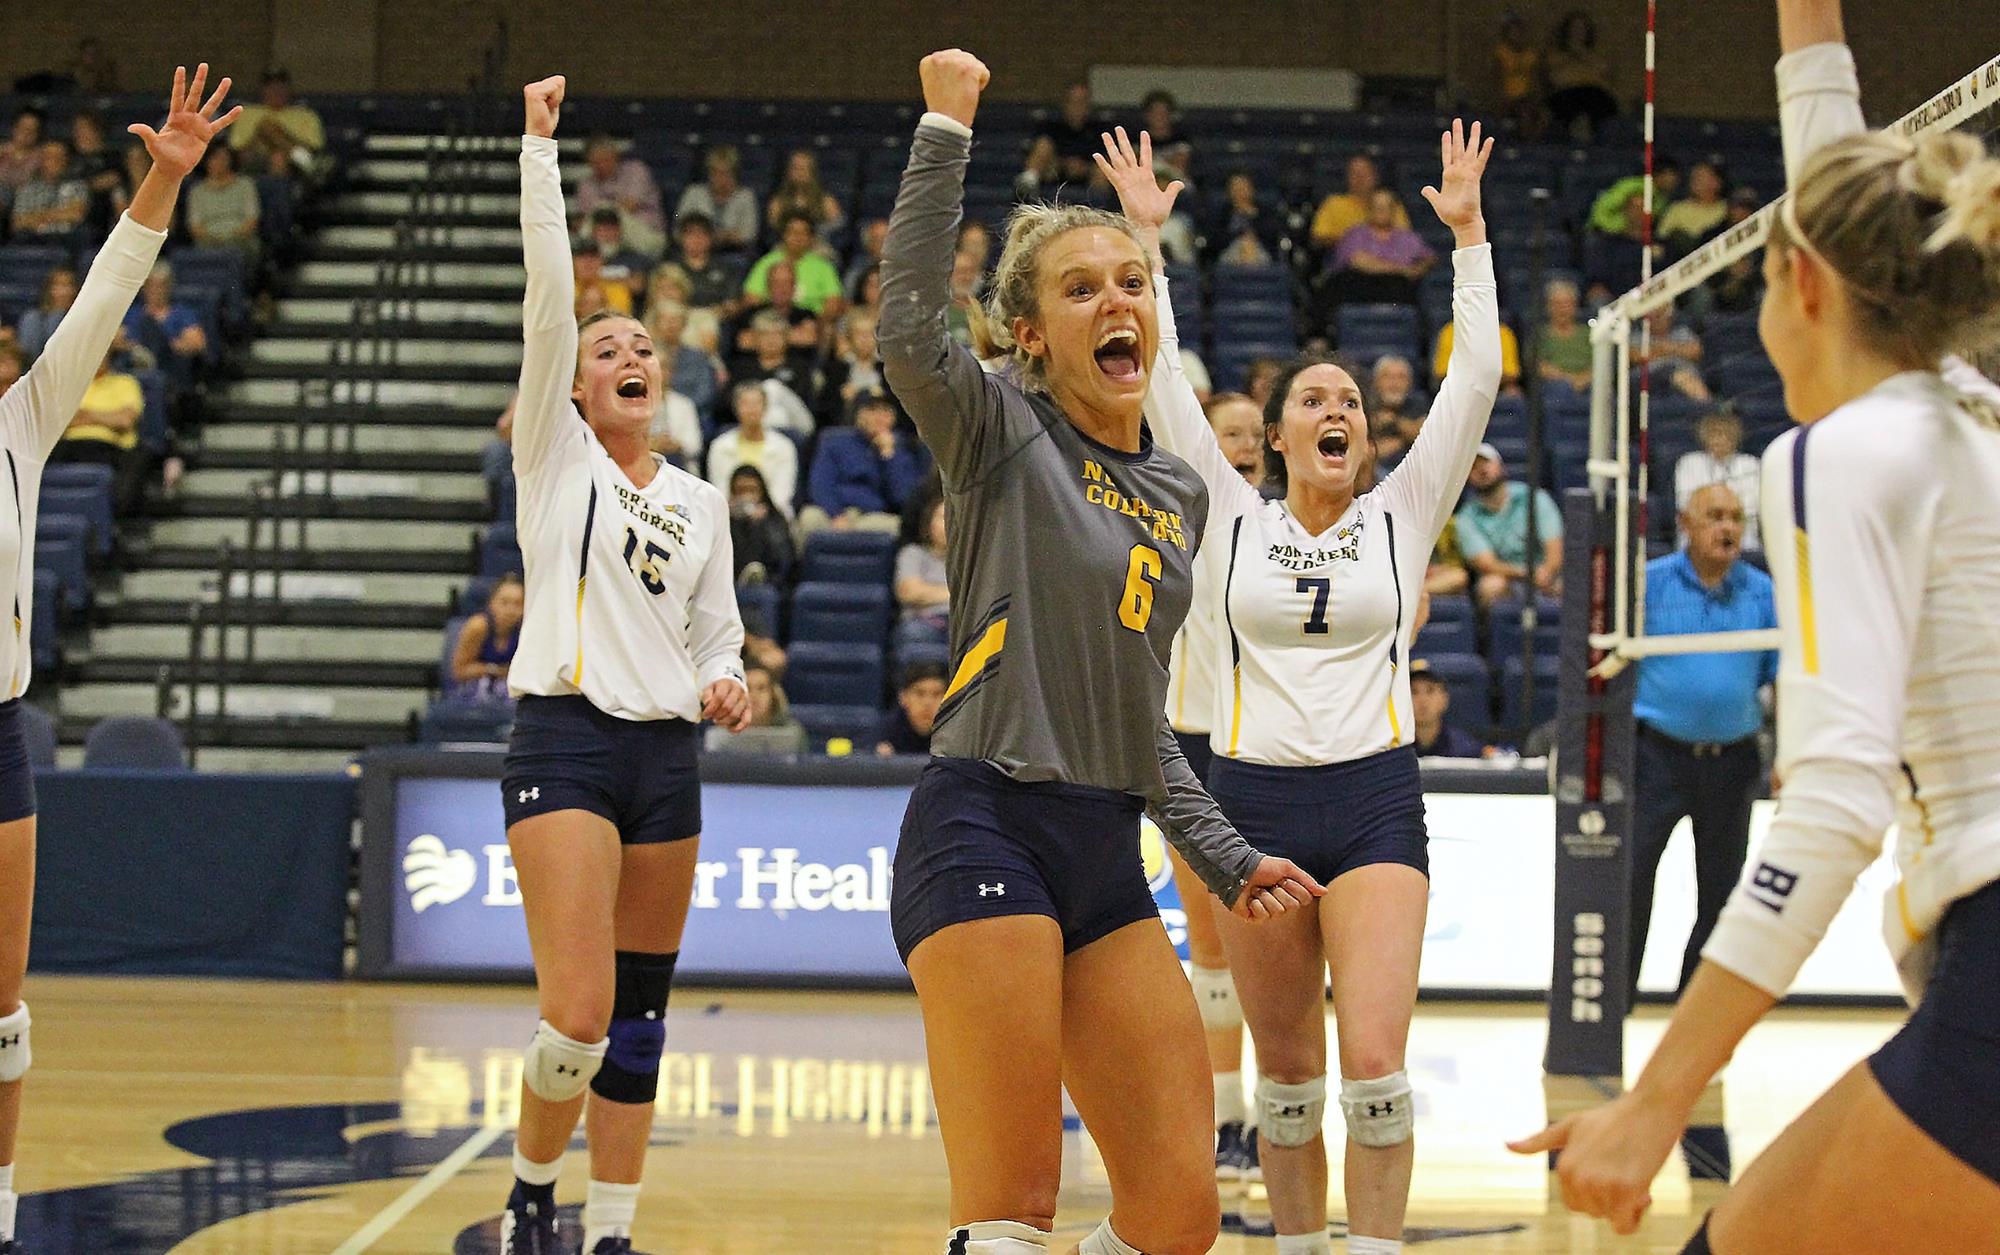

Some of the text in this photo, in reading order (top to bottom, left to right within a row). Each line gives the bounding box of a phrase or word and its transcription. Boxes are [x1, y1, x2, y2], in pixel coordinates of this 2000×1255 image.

[622, 525, 672, 597] 15
[1116, 542, 1164, 635] 6
[1294, 576, 1332, 635] 7
[735, 846, 893, 912] Heal
